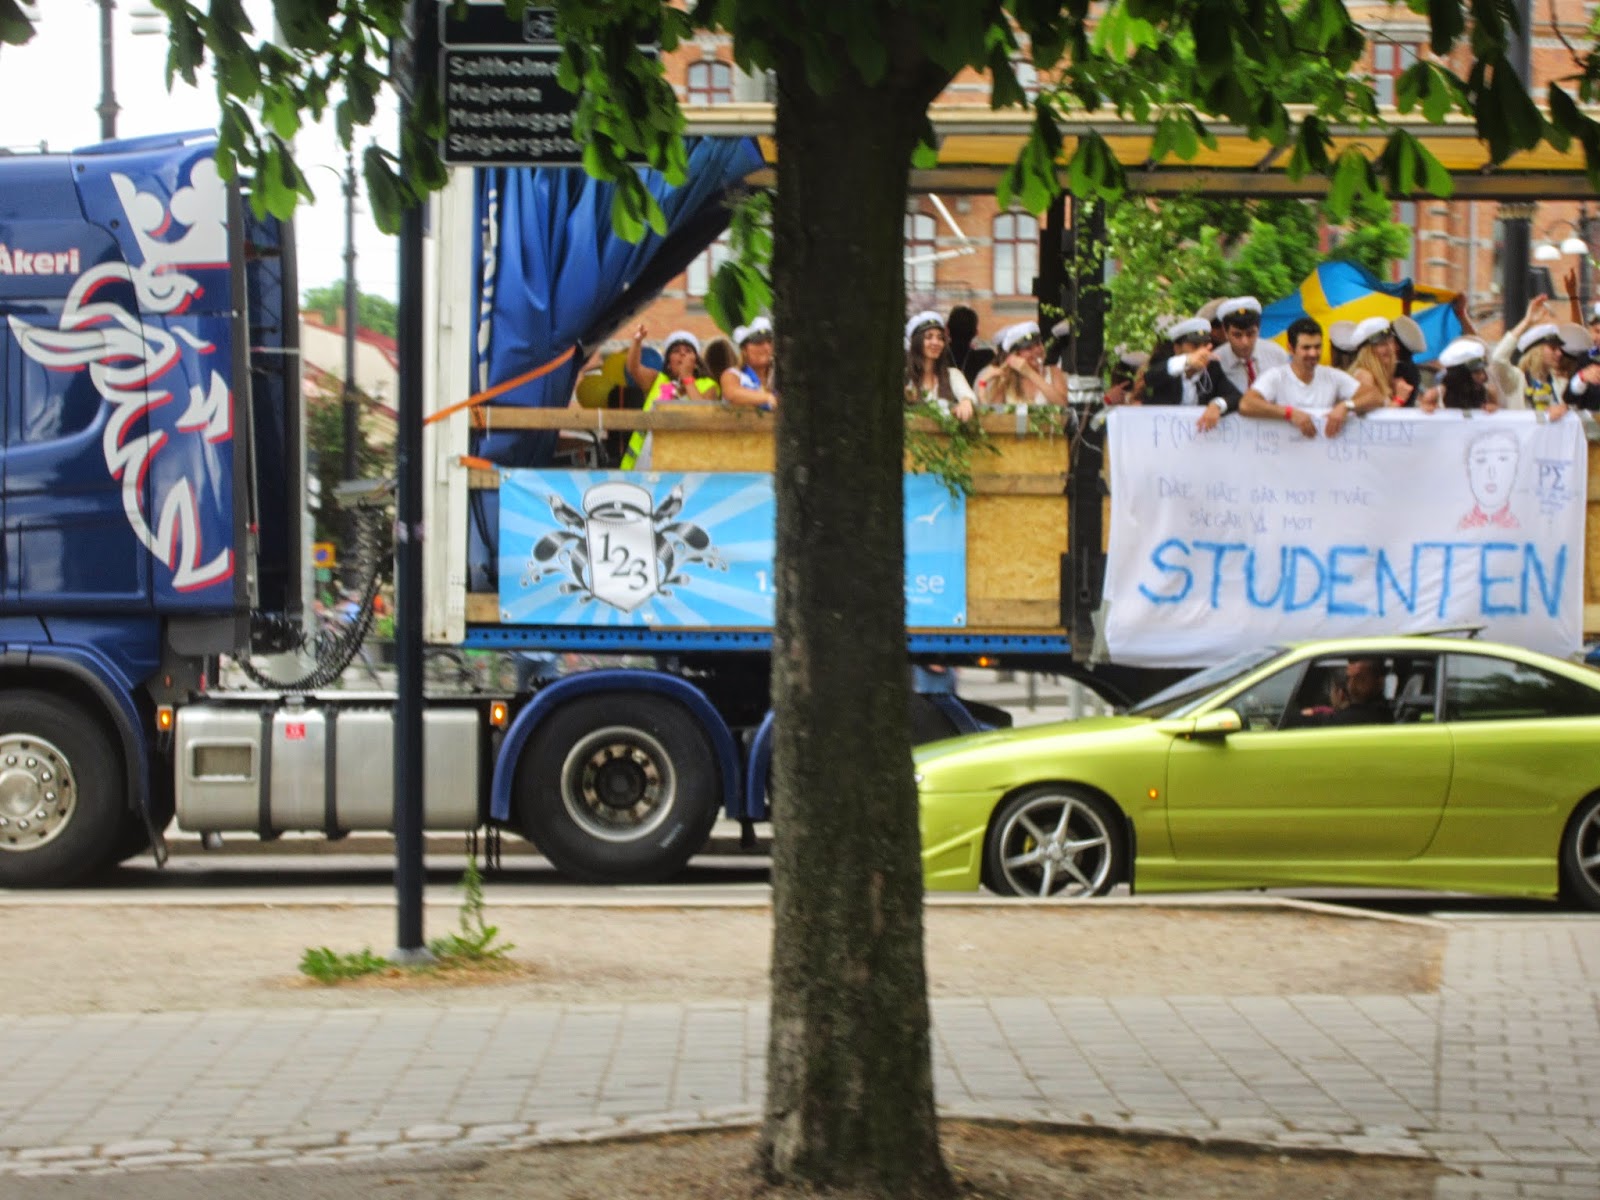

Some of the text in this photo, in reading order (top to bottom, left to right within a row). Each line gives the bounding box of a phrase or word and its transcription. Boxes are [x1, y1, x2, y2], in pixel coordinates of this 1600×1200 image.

[449, 56, 560, 76] Saltholme
[449, 82, 542, 105] Majorna
[1138, 538, 1568, 618] STUDENTEN
